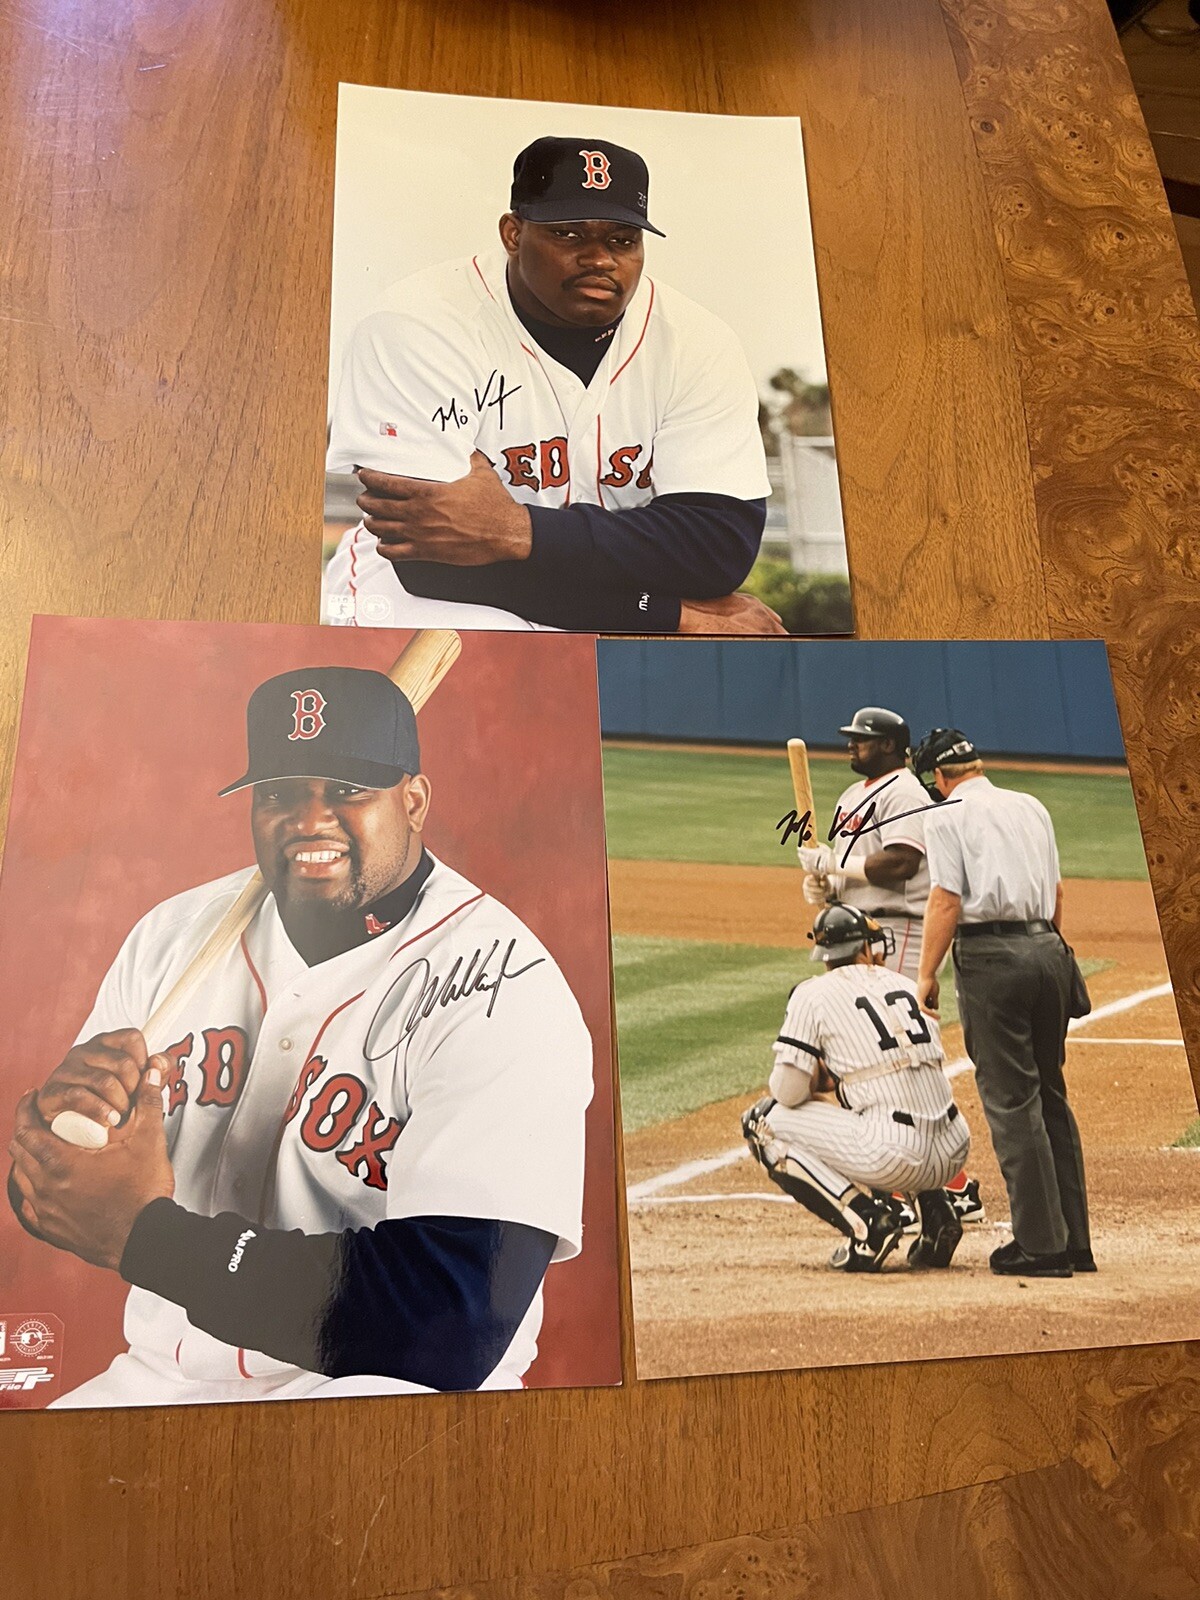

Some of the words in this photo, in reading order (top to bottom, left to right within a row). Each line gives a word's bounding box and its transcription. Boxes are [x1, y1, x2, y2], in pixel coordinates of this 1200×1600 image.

[579, 150, 612, 190] B
[476, 436, 570, 493] ED
[288, 688, 328, 741] B
[855, 990, 932, 1051] 13
[163, 1025, 251, 1116] ED
